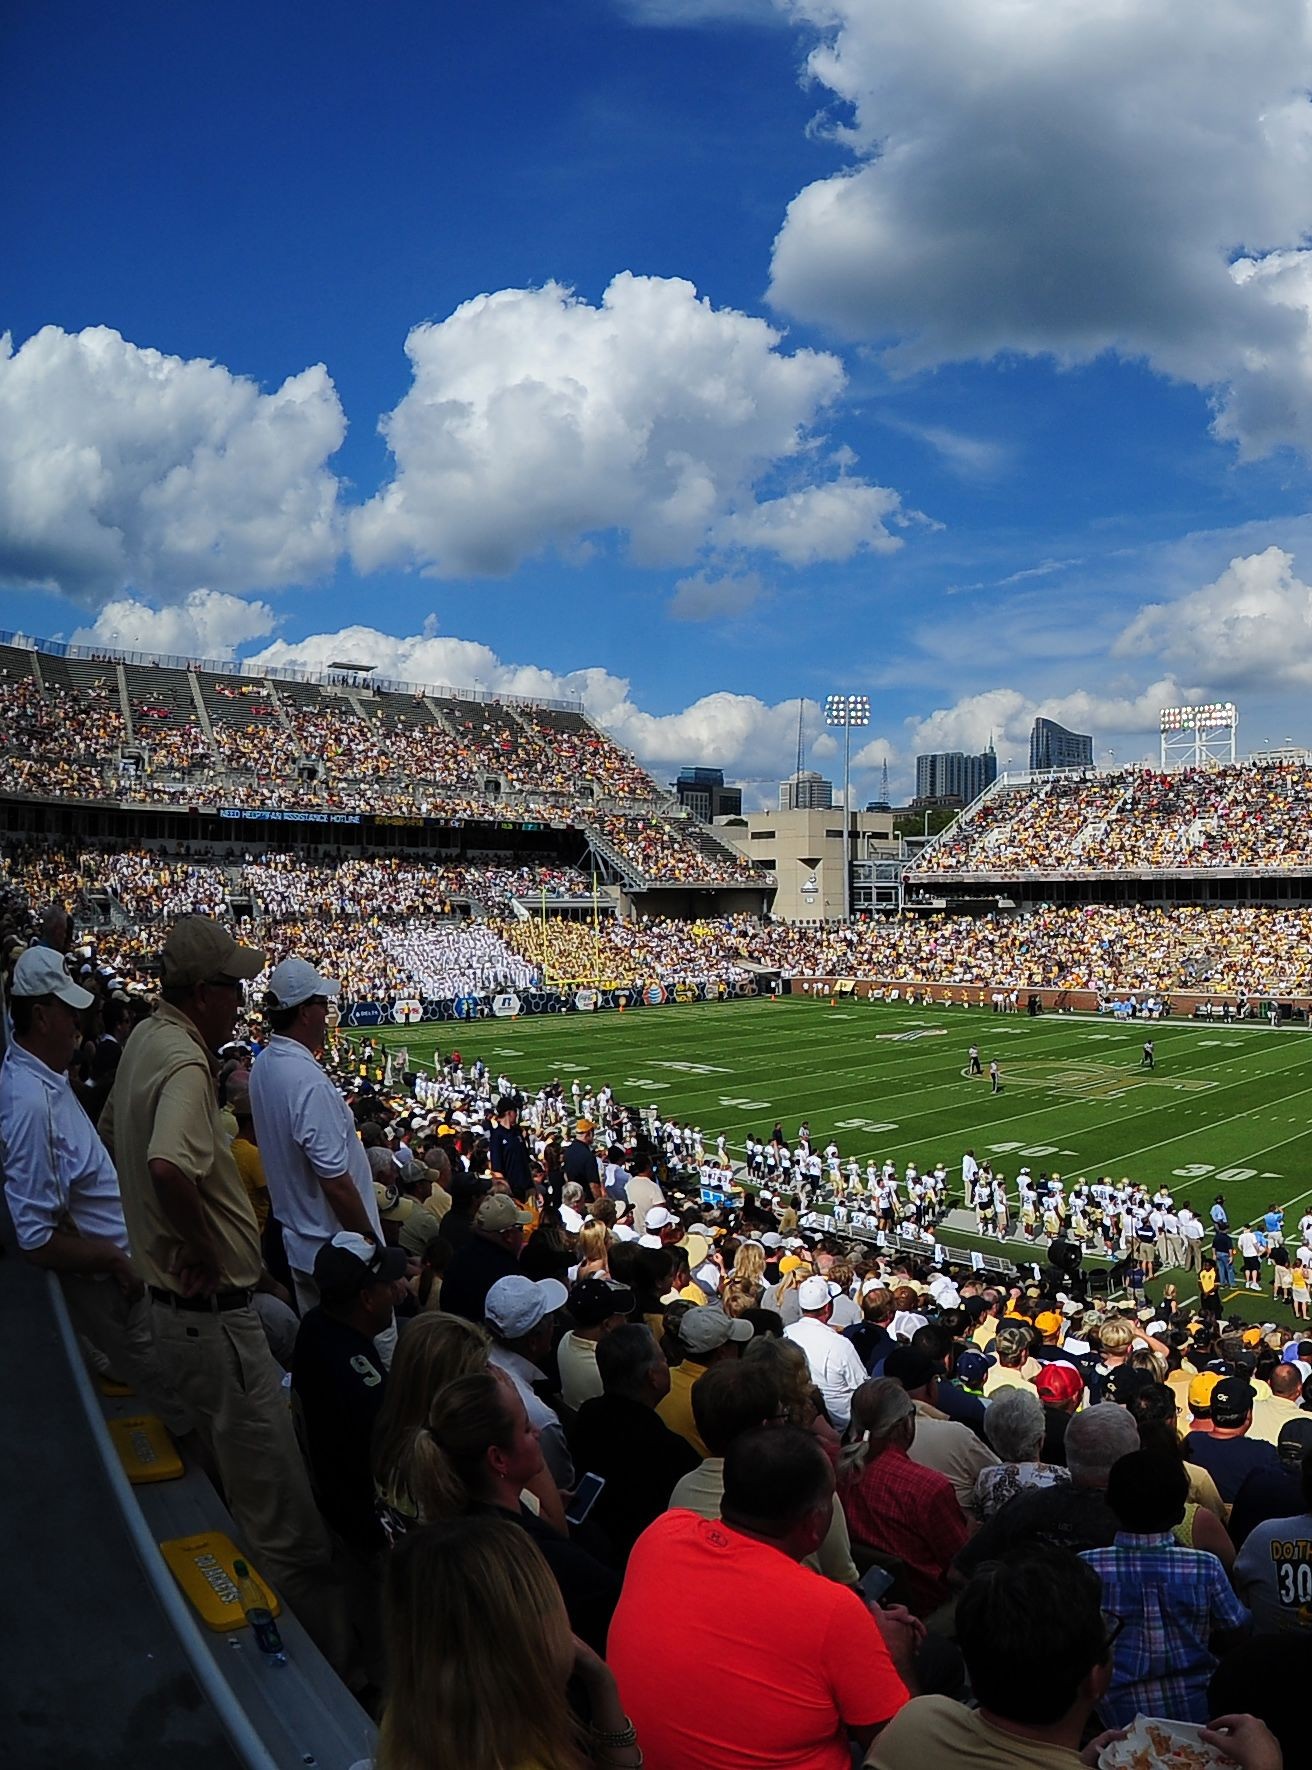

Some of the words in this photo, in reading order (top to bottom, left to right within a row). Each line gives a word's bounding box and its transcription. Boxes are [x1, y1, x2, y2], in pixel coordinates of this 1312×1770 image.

[220, 809, 240, 819] NEED
[330, 815, 360, 824] HOTLINE
[833, 1117, 900, 1133] 50
[984, 1141, 1060, 1157] 40
[1171, 1163, 1258, 1182] 30
[350, 1354, 382, 1387] 9
[1271, 1540, 1295, 1561] DO
[202, 1567, 242, 1605] JACKETS
[1280, 1562, 1312, 1603] 30
